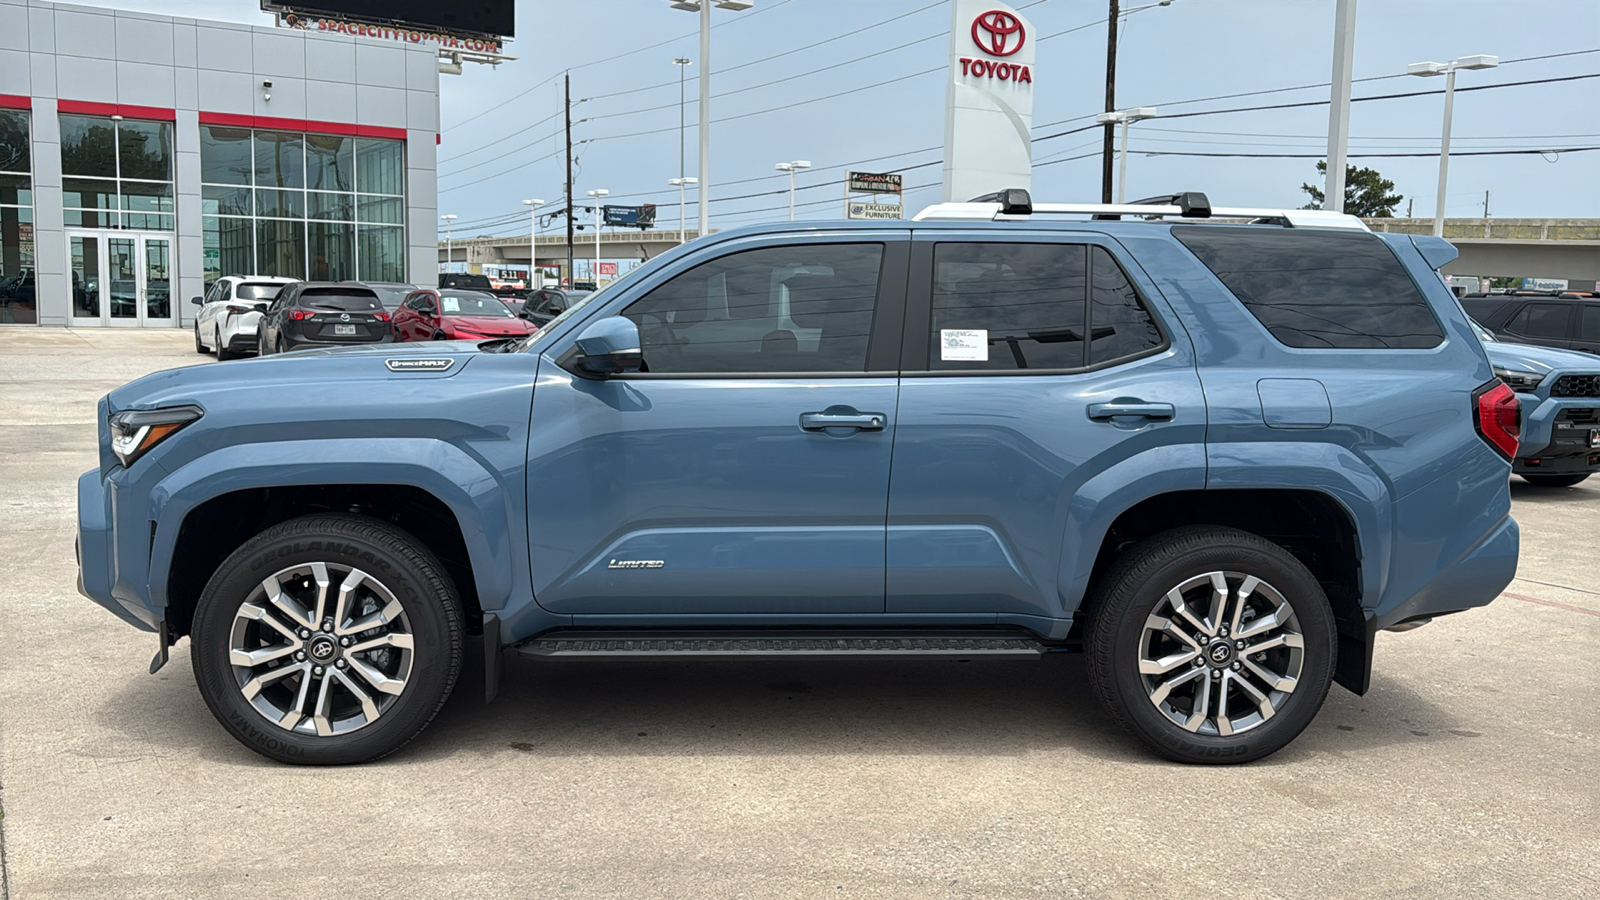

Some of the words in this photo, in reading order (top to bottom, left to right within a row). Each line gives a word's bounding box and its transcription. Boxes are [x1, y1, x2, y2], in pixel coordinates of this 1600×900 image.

[318, 19, 497, 53] SPACECITYTOYOTA.COM
[959, 58, 1032, 83] TOYOTA
[249, 541, 392, 572] GEOLANDAR
[228, 708, 306, 759] YOKOHAMA
